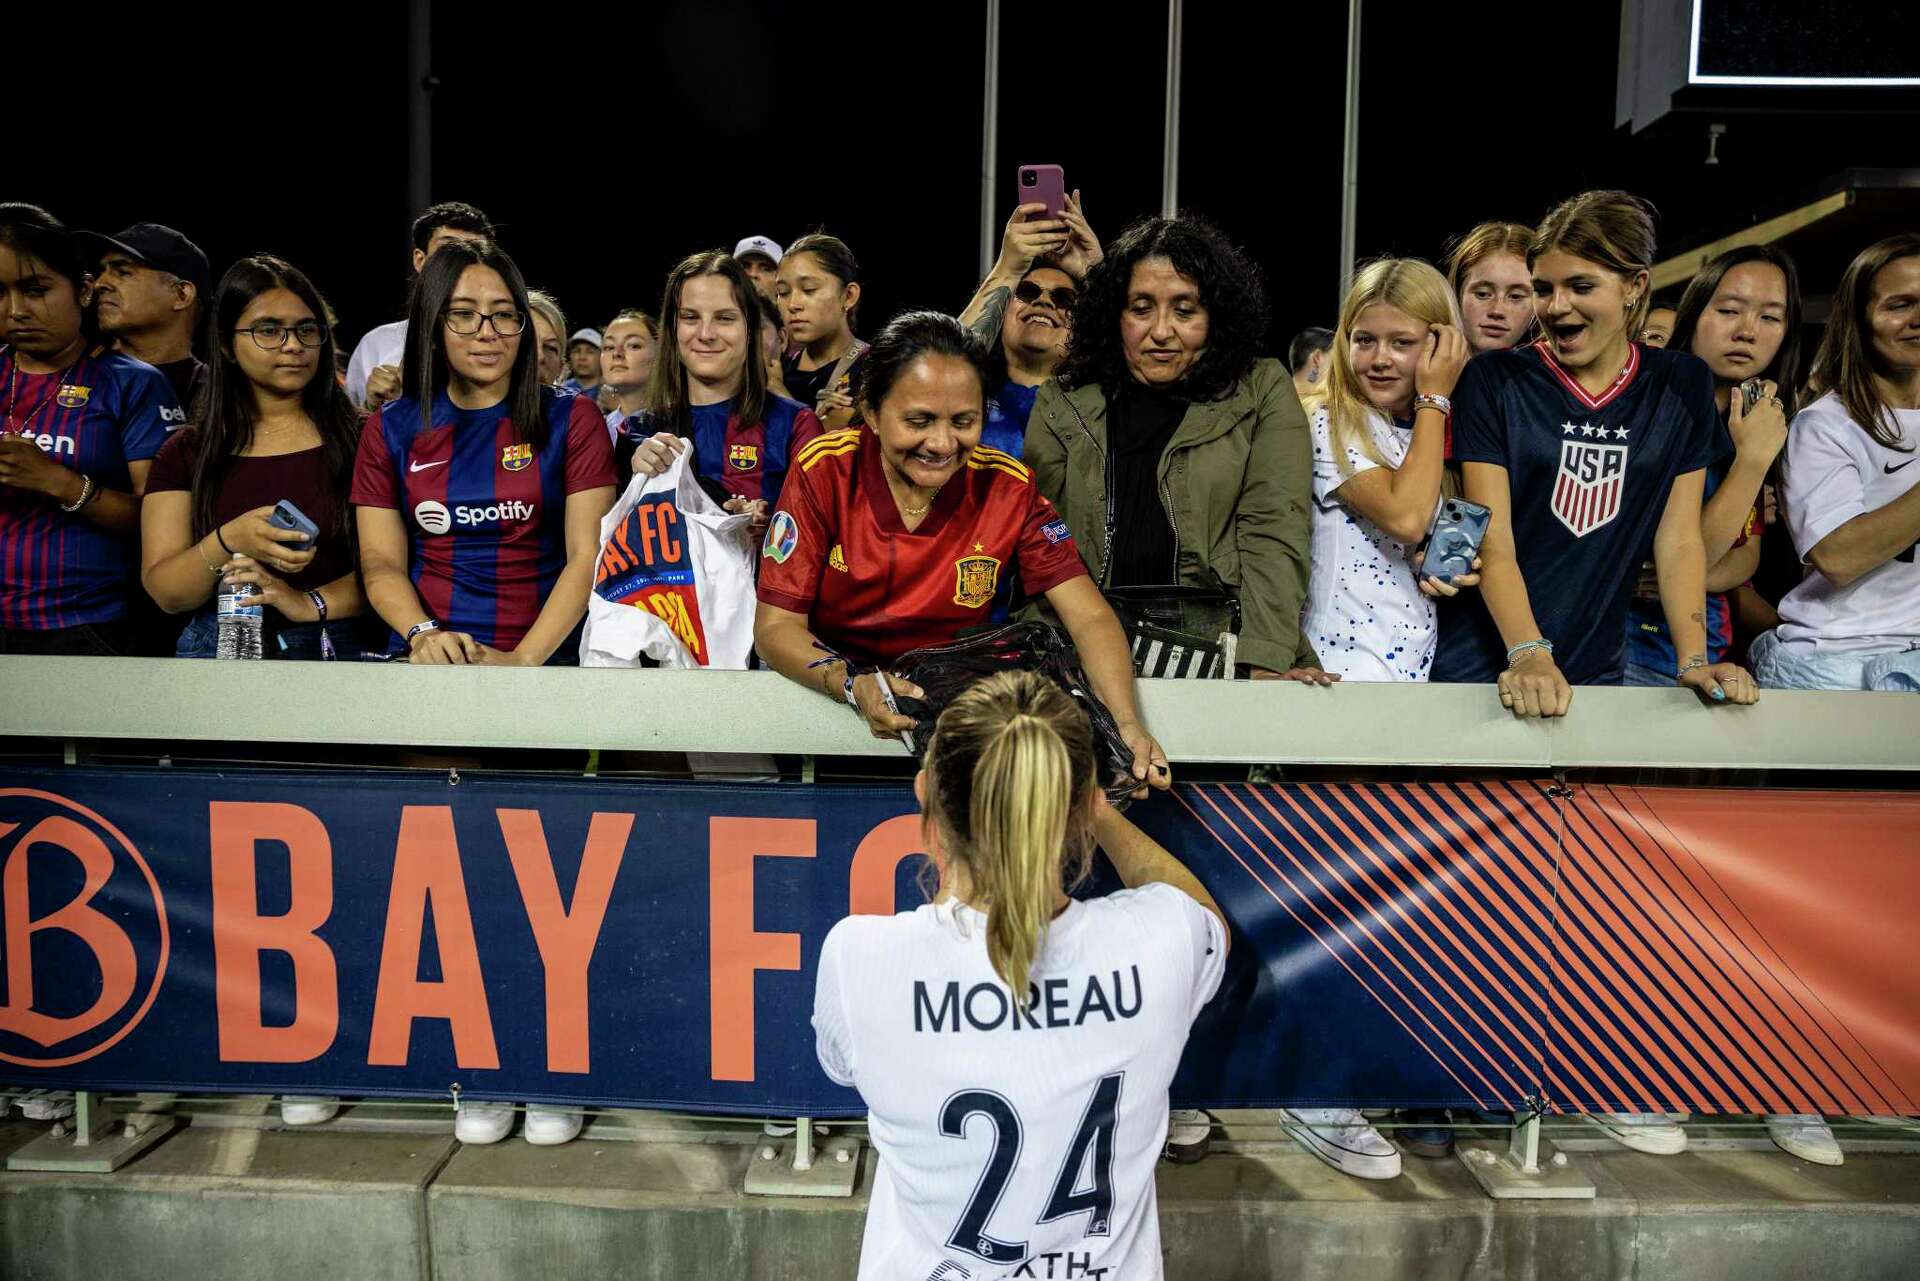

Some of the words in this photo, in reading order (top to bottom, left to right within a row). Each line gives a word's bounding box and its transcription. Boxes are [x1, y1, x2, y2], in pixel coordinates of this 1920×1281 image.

[1565, 445, 1623, 484] USA
[455, 501, 535, 526] Spotify
[639, 502, 682, 566] FC
[209, 800, 636, 1074] BAY
[913, 964, 1143, 1033] MOREAU
[938, 1069, 1126, 1267] 24
